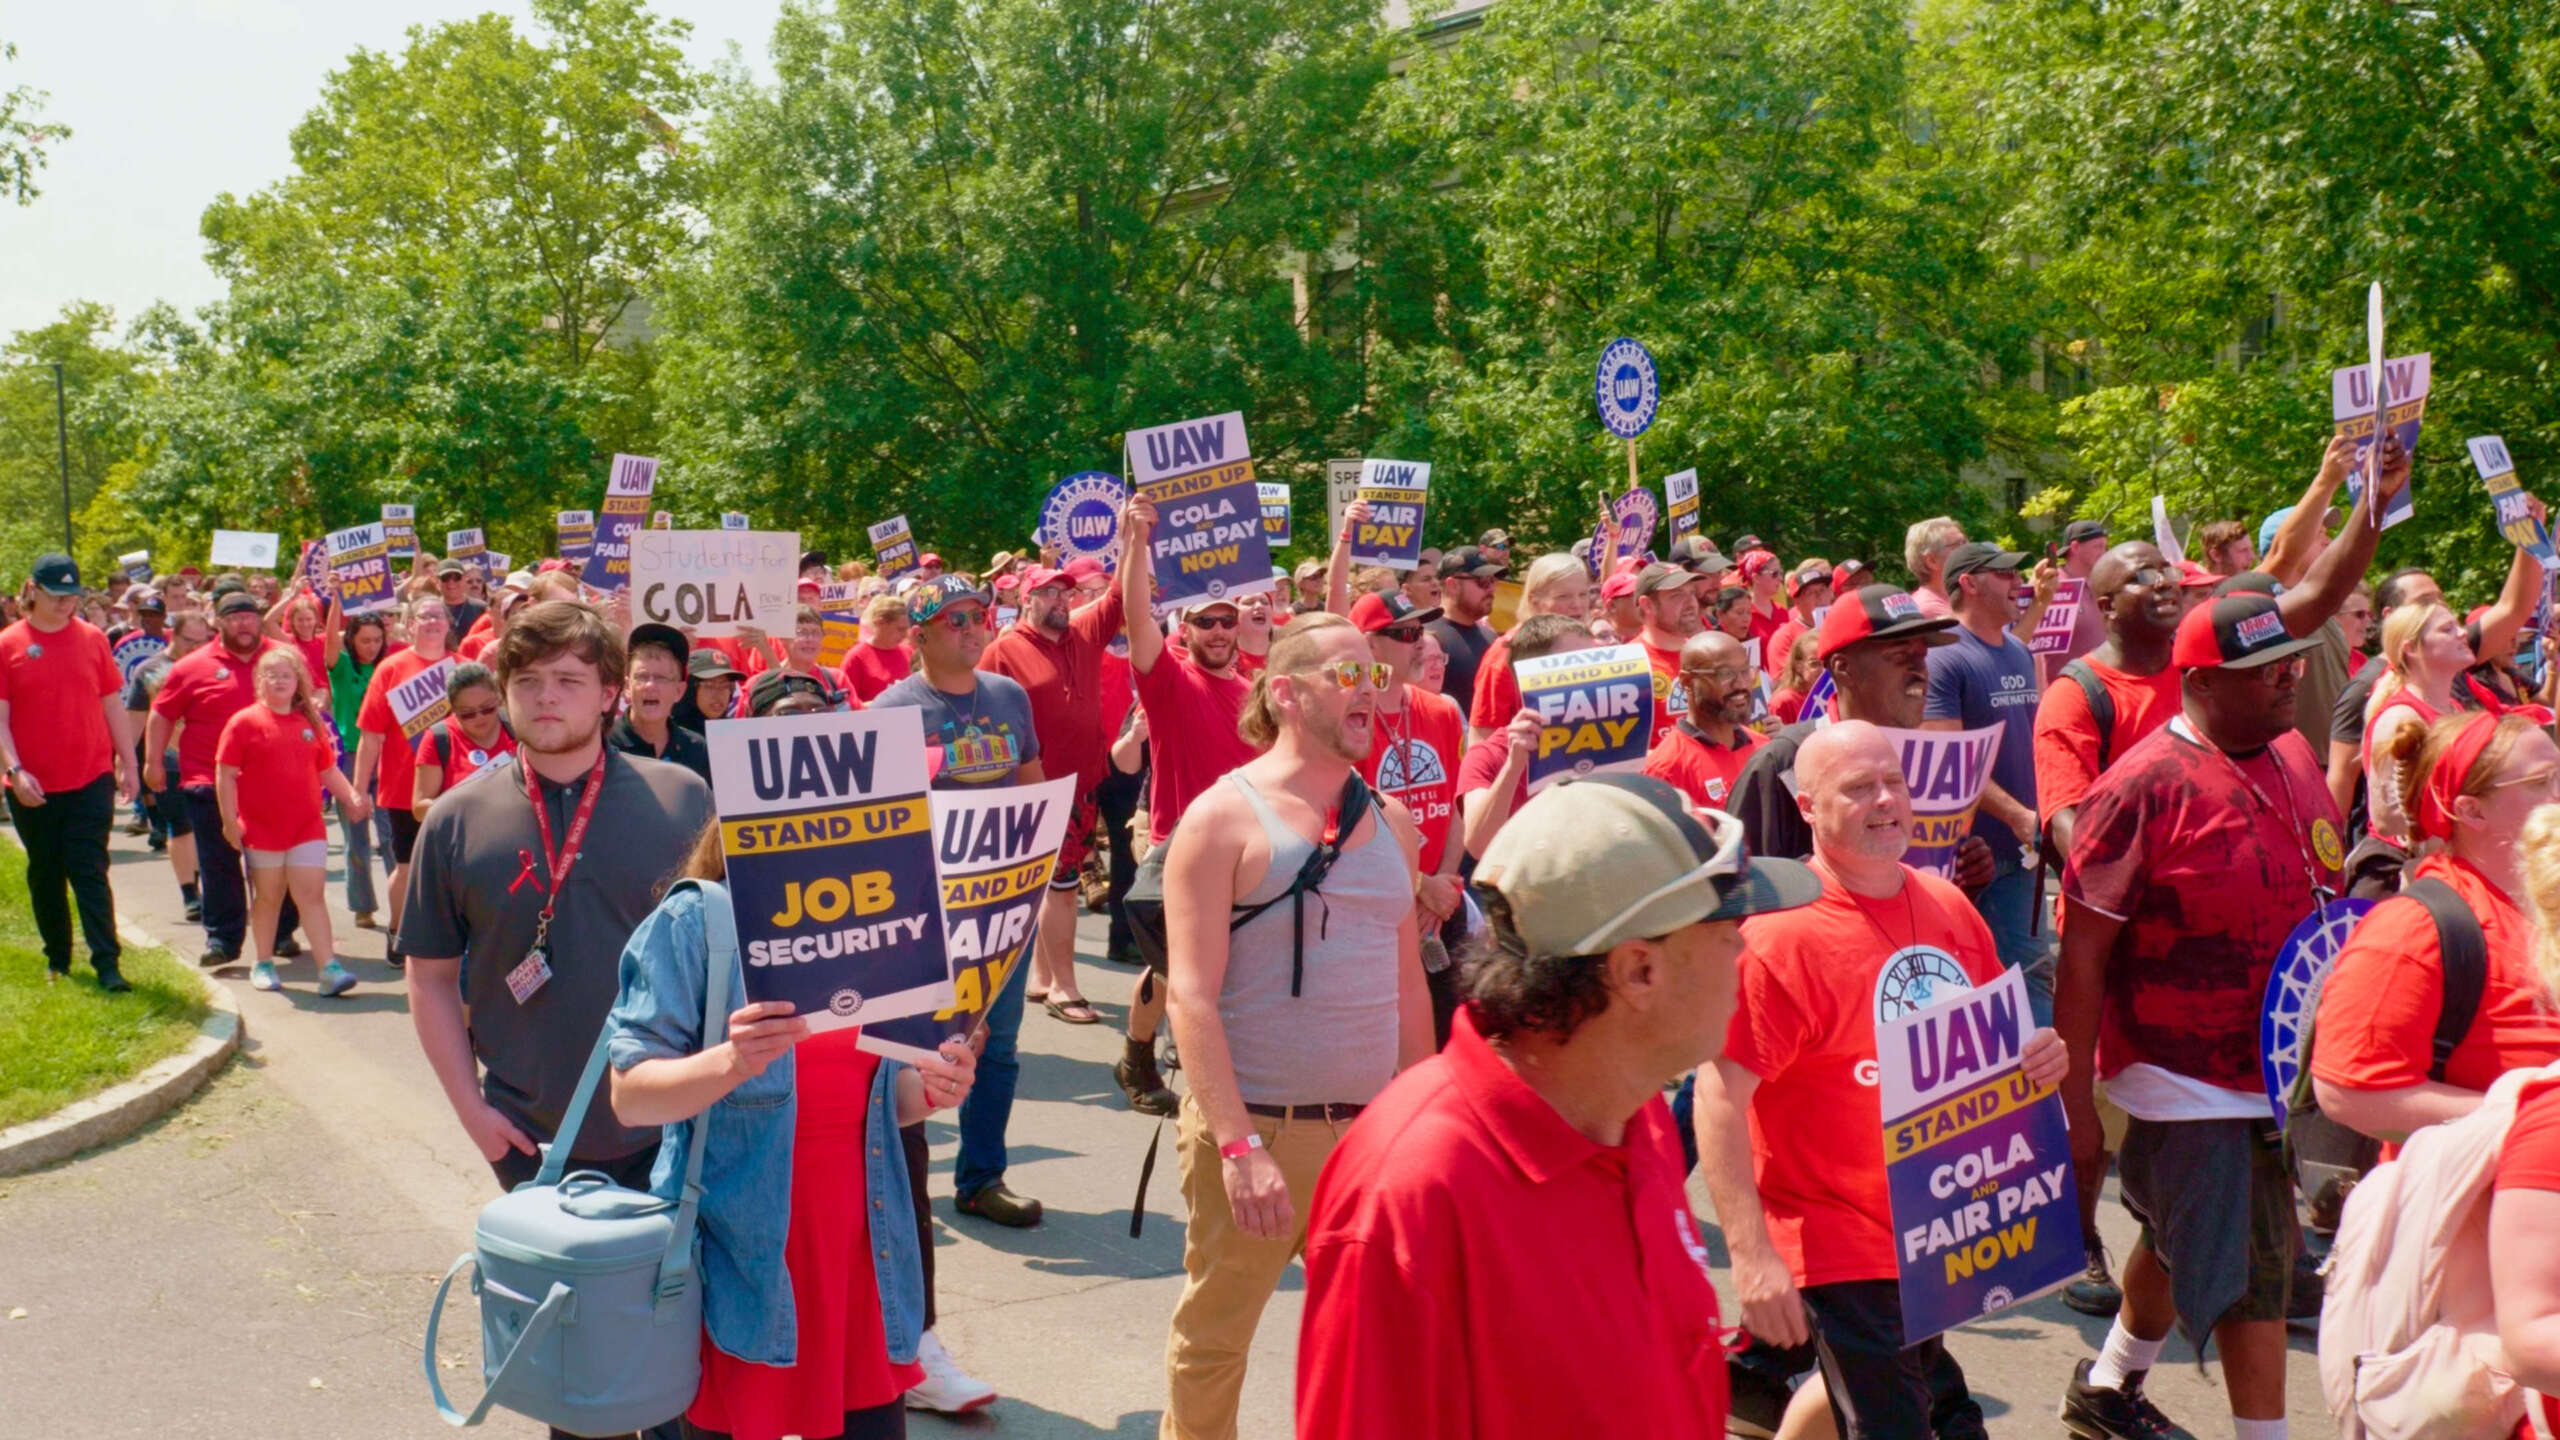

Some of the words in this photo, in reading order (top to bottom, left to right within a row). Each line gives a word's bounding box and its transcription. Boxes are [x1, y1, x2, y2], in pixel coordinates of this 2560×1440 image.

[1616, 378, 1640, 400] UAW
[2350, 360, 2415, 408] UW
[2343, 412, 2398, 439] STAD
[2401, 404, 2421, 420] UP
[1147, 421, 1224, 471] UAW
[620, 459, 653, 491] UAW
[1145, 475, 1213, 499] STAND
[1220, 466, 1246, 483] UP
[1334, 472, 1360, 484] SPE
[1373, 464, 1416, 487] UAW
[1260, 487, 1279, 496] AW
[1363, 490, 1402, 500] STAND
[1404, 492, 1420, 501] UP
[1071, 515, 1111, 538] UAW
[1169, 499, 1236, 527] COLA
[1261, 506, 1285, 518] AIR
[1263, 518, 1285, 532] AY
[1367, 504, 1416, 525] FAIR
[337, 528, 371, 550] UAW
[452, 531, 476, 547] UAW
[875, 522, 899, 539] UAW
[1155, 532, 1209, 559] FAIR
[1213, 518, 1258, 542] PAY
[1359, 524, 1415, 547] PAY
[595, 542, 629, 558] FAIR
[880, 543, 912, 562] FAIR
[1181, 544, 1239, 574] NOW
[338, 558, 384, 581] FAIR
[605, 560, 630, 574] NO
[341, 573, 385, 600] PAY
[643, 582, 754, 624] COLA
[2040, 608, 2070, 629] ITH
[1540, 649, 1617, 669] UAW
[398, 667, 446, 712] UAW
[1529, 669, 1602, 687] STAND
[1609, 663, 1638, 673] UP
[2000, 675, 2026, 690] GOD
[1538, 683, 1639, 725] FAIR
[406, 704, 447, 734] STAND
[1538, 717, 1640, 760] PAY
[748, 730, 878, 801] UAW
[1901, 735, 1993, 800] UAW
[1428, 802, 1451, 819] Da
[736, 816, 851, 850] STAND
[864, 806, 911, 834] UP
[940, 799, 1048, 865] UAW
[1912, 818, 1964, 842] AND
[943, 877, 1008, 904] AND
[1016, 864, 1045, 890] UP
[772, 870, 895, 928] JOB
[748, 913, 928, 967] SECURITY
[947, 903, 1032, 962] AIR
[932, 947, 1019, 1021] AY
[1907, 984, 2021, 1094] UAW
[1896, 1091, 2000, 1153] STAND
[1929, 1133, 2034, 1199] COLA
[1971, 1180, 1999, 1201] AND
[1904, 1197, 1991, 1263] FAIR
[1997, 1164, 2066, 1222] PAY
[1944, 1217, 2038, 1285] NOW
